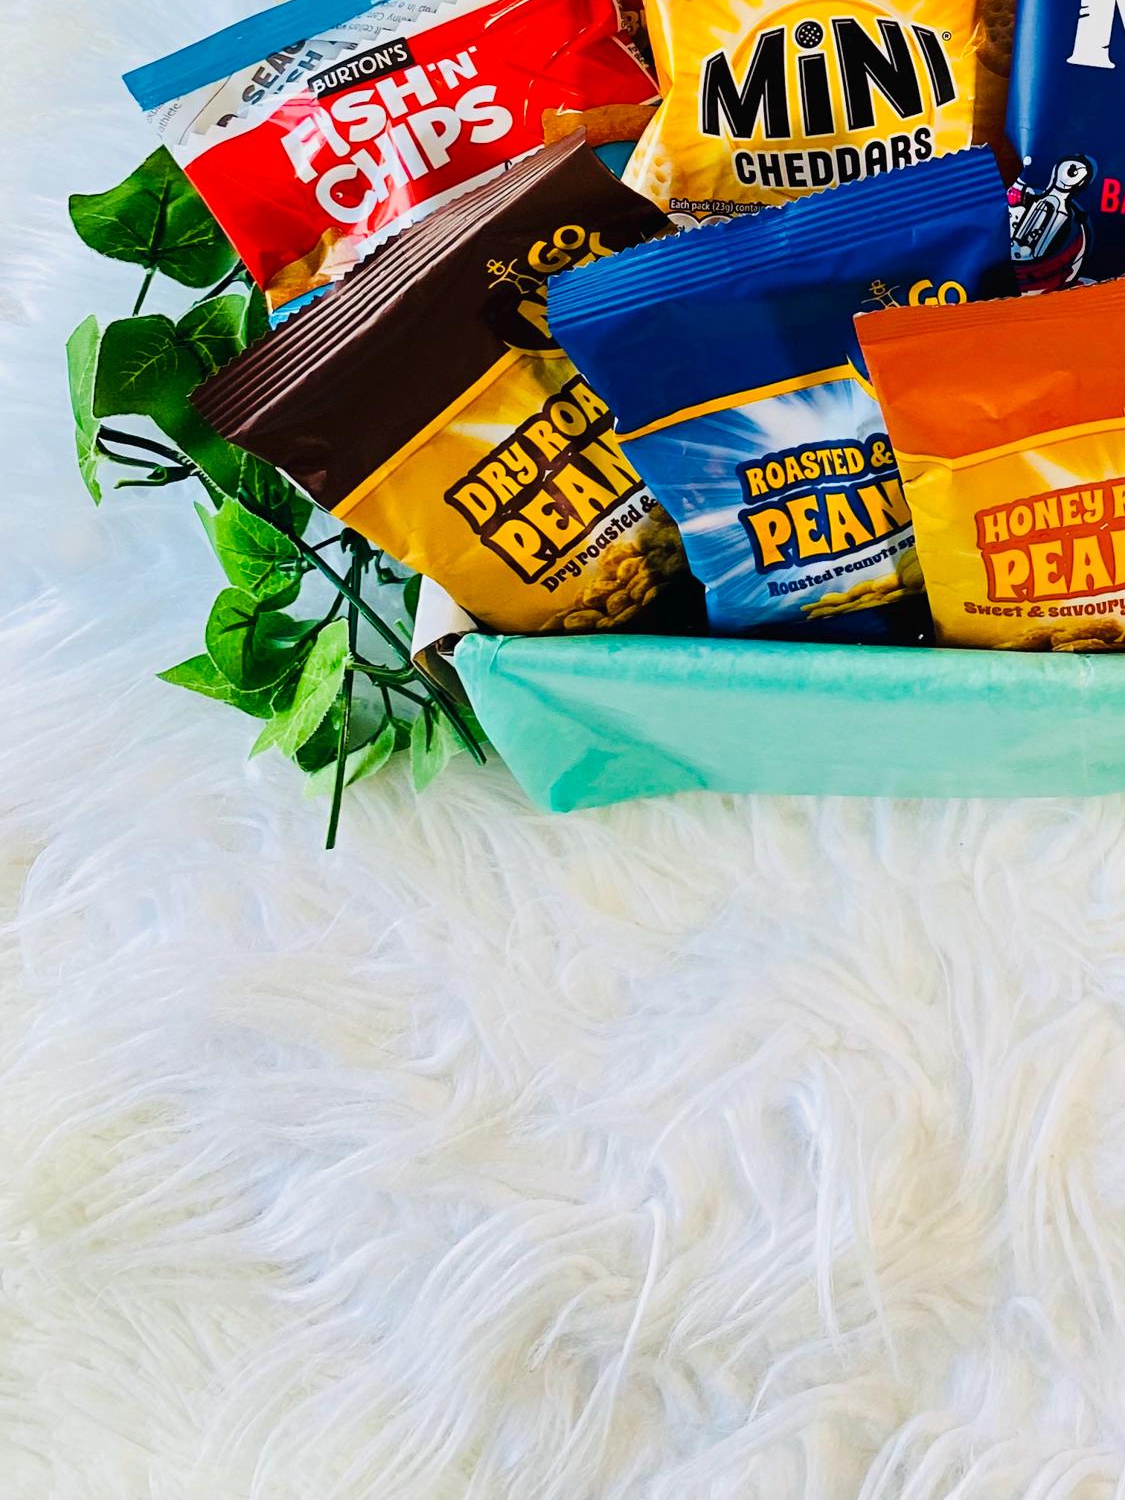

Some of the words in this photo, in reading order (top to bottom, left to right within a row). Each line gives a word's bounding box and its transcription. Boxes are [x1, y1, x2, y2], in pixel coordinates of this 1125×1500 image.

[310, 43, 409, 95] BURTON'S
[280, 64, 439, 184] FISH
[315, 84, 514, 224] CHIPS
[734, 127, 933, 190] CHEDDARS
[670, 199, 690, 211] Each
[691, 200, 710, 213] pack
[712, 201, 734, 214] (23g)
[527, 225, 586, 273] GO
[908, 279, 968, 308] GO
[454, 440, 540, 527] DRY
[745, 448, 865, 497] ROASTED
[870, 440, 893, 468] &
[540, 559, 583, 593] Dry
[576, 504, 644, 566] roasted
[641, 494, 658, 513] &
[982, 486, 1105, 545] HONEY
[768, 569, 834, 598] Roasted
[834, 545, 897, 578] Peanuts
[963, 601, 1023, 618] Sweet
[1026, 601, 1045, 618] &
